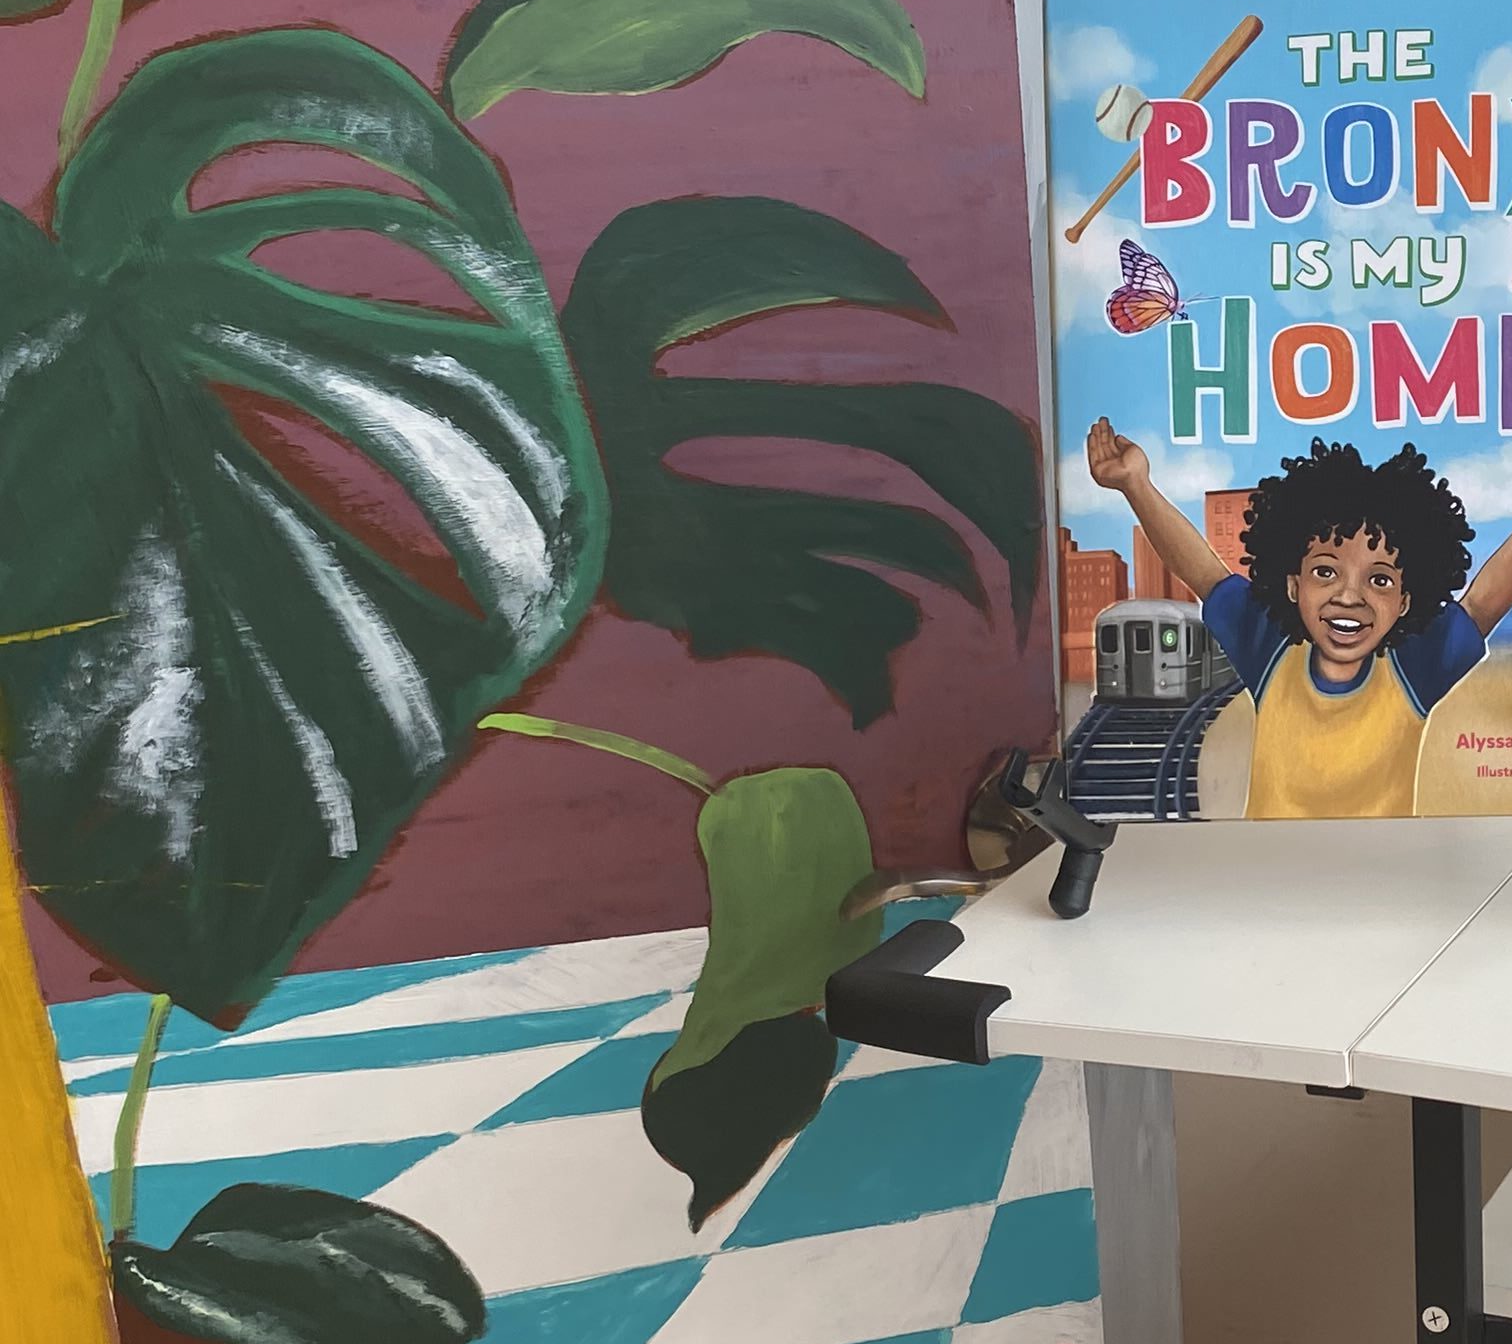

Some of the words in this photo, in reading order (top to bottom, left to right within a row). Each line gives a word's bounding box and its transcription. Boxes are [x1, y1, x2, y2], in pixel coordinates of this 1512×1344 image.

[1287, 29, 1435, 87] THE
[1270, 239, 1332, 291] IS
[1166, 632, 1173, 644] 6
